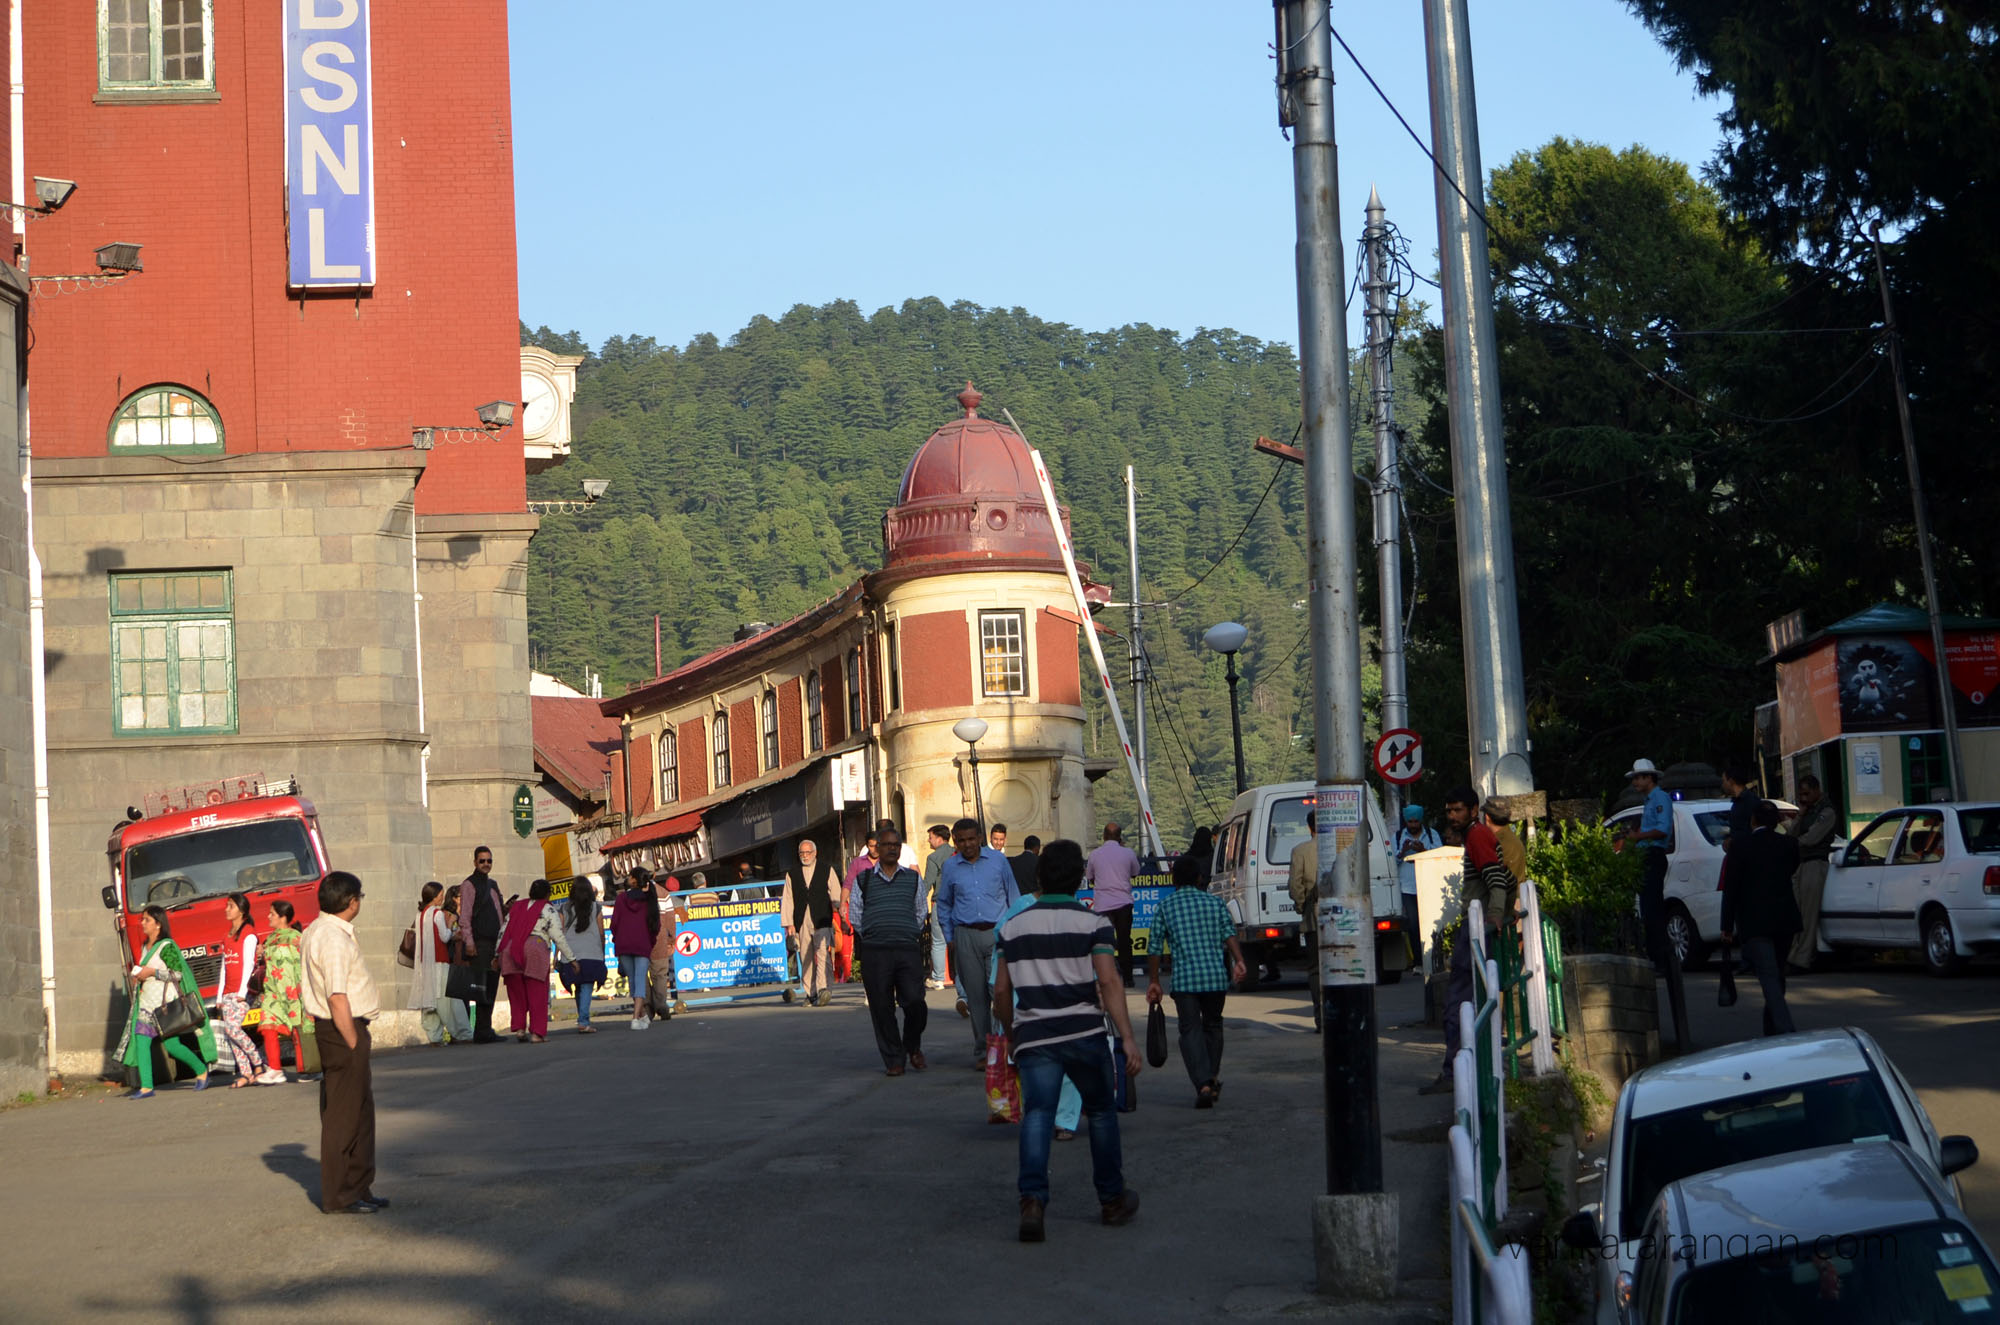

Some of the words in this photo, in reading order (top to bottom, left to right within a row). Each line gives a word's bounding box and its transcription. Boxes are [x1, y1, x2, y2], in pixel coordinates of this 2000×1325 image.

[1319, 792, 1357, 802] STITUTE
[190, 814, 218, 828] FIRE
[1131, 889, 1160, 902] ORE
[688, 905, 718, 920] SHIMLA
[720, 903, 751, 918] TRAFFIC
[753, 900, 780, 915] POLICE
[722, 919, 760, 933] CORE
[702, 937, 741, 950] MALL
[744, 932, 783, 946] ROAD
[724, 949, 742, 957] CTO
[697, 971, 719, 979] State
[721, 968, 743, 977] Bank
[757, 965, 785, 973] Patiala
